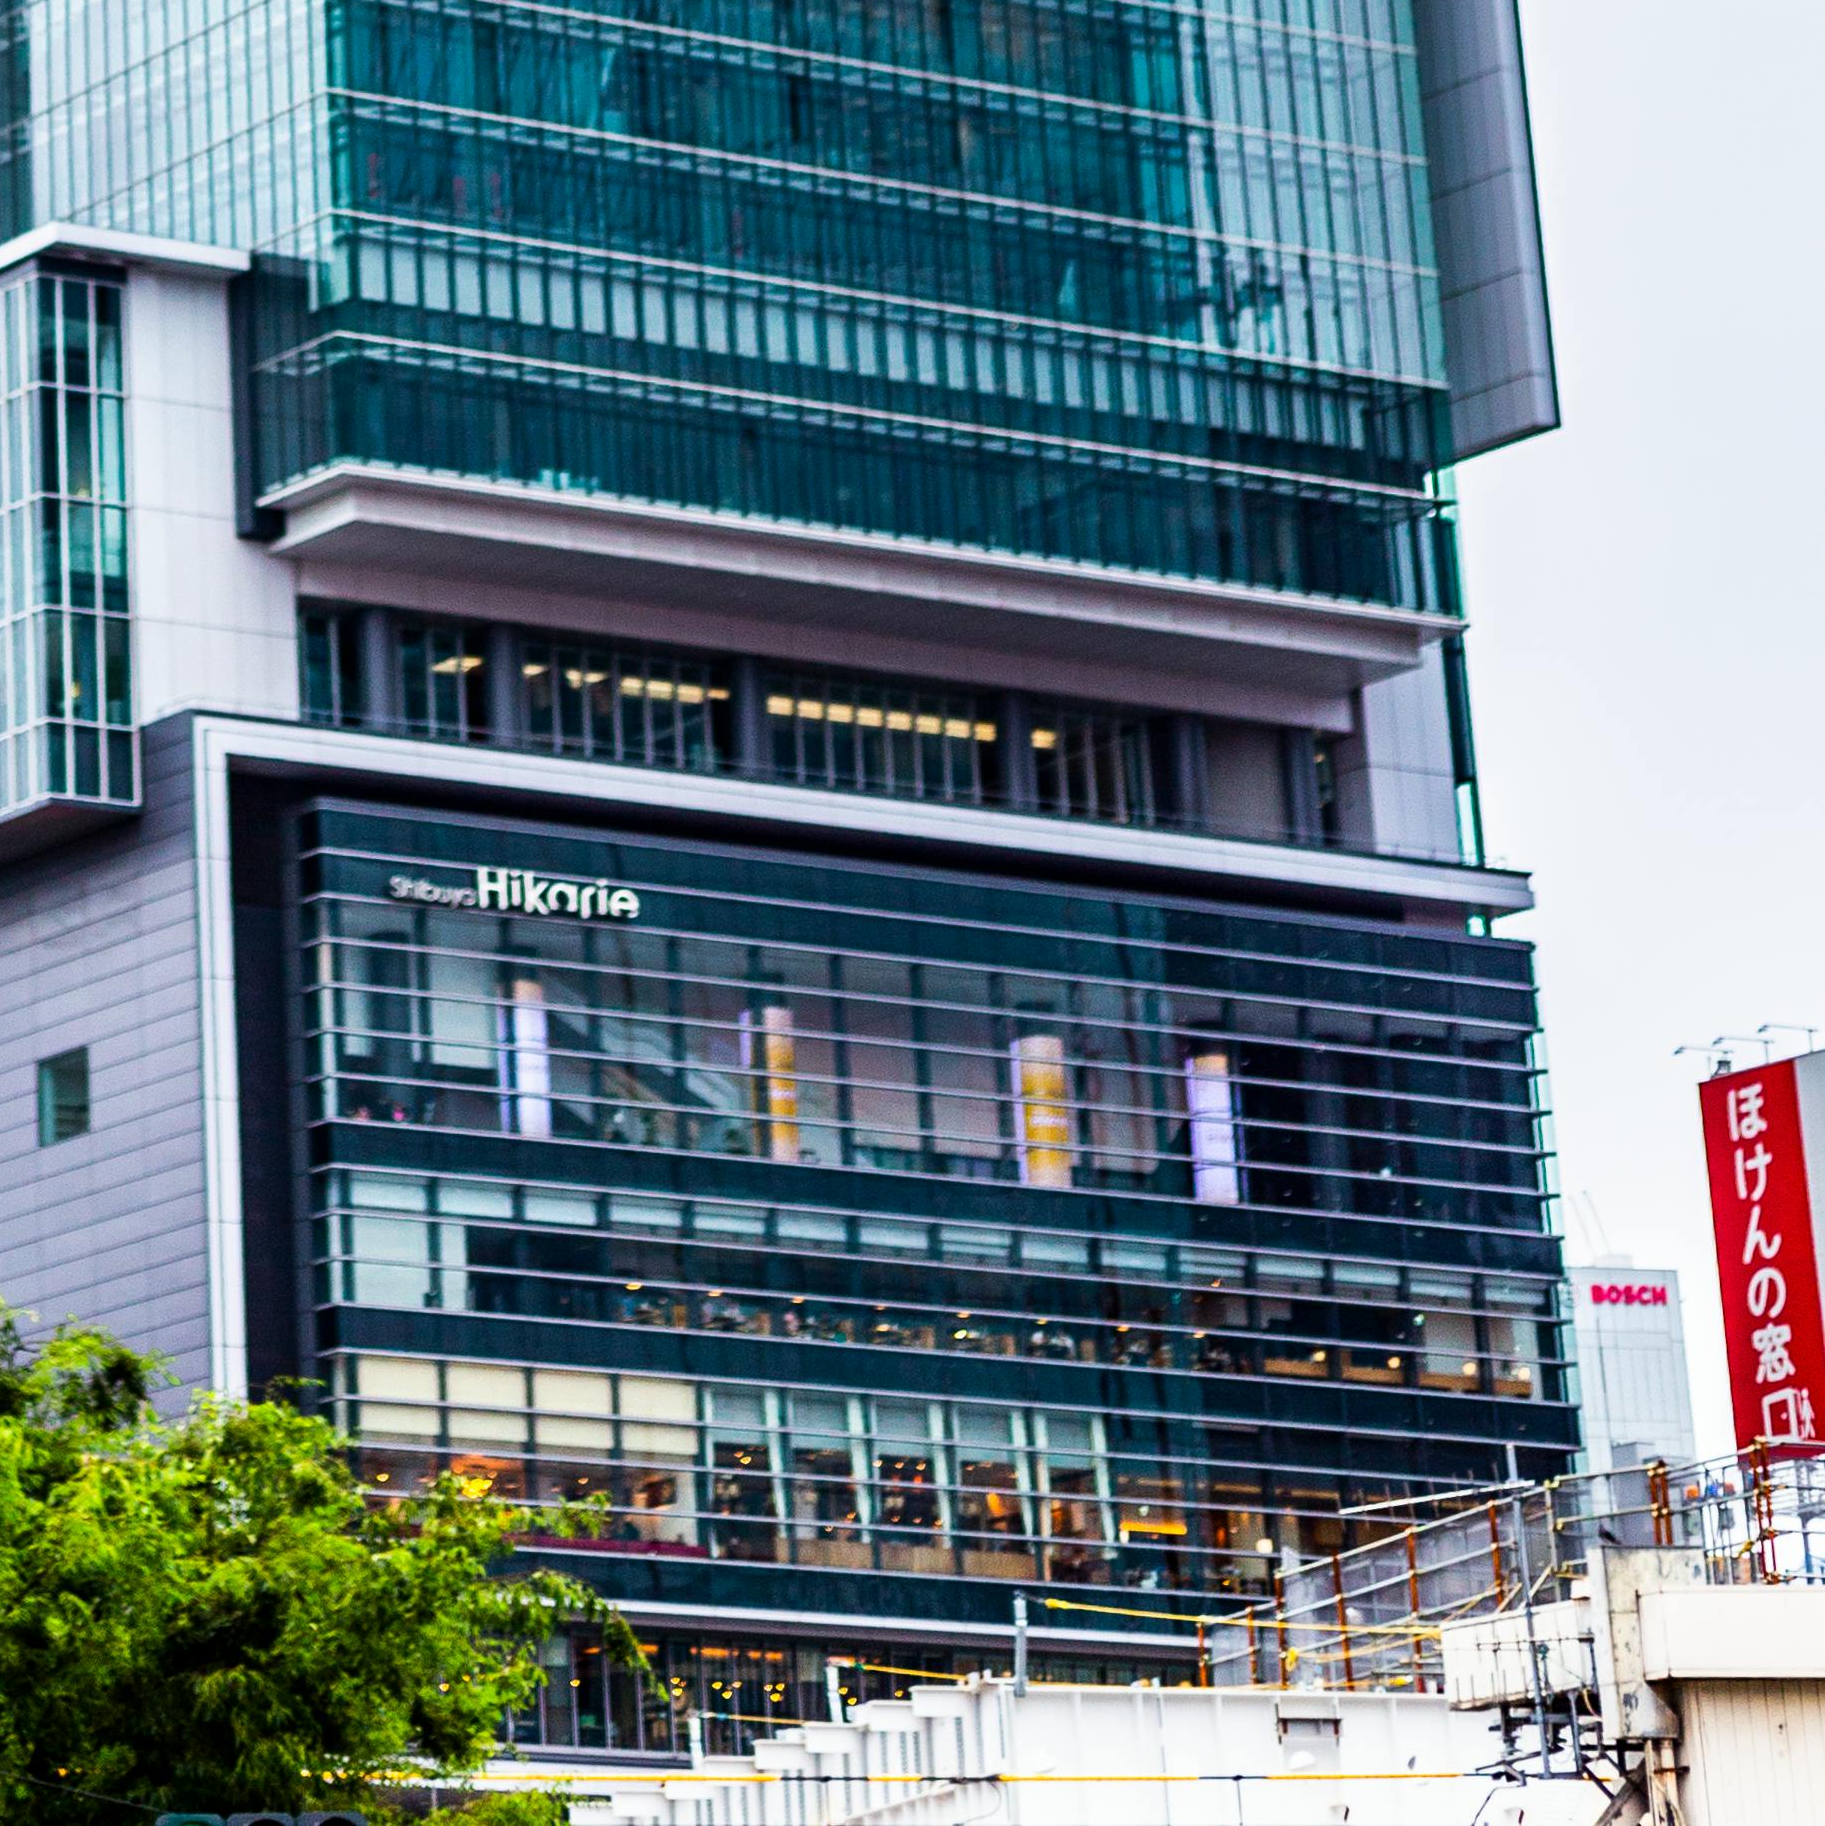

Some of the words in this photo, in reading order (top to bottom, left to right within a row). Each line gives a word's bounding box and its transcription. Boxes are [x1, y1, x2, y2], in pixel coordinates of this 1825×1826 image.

[389, 874, 477, 908] Shibuya
[477, 865, 641, 919] Hikarie
[1590, 1283, 1668, 1306] BOSCH
